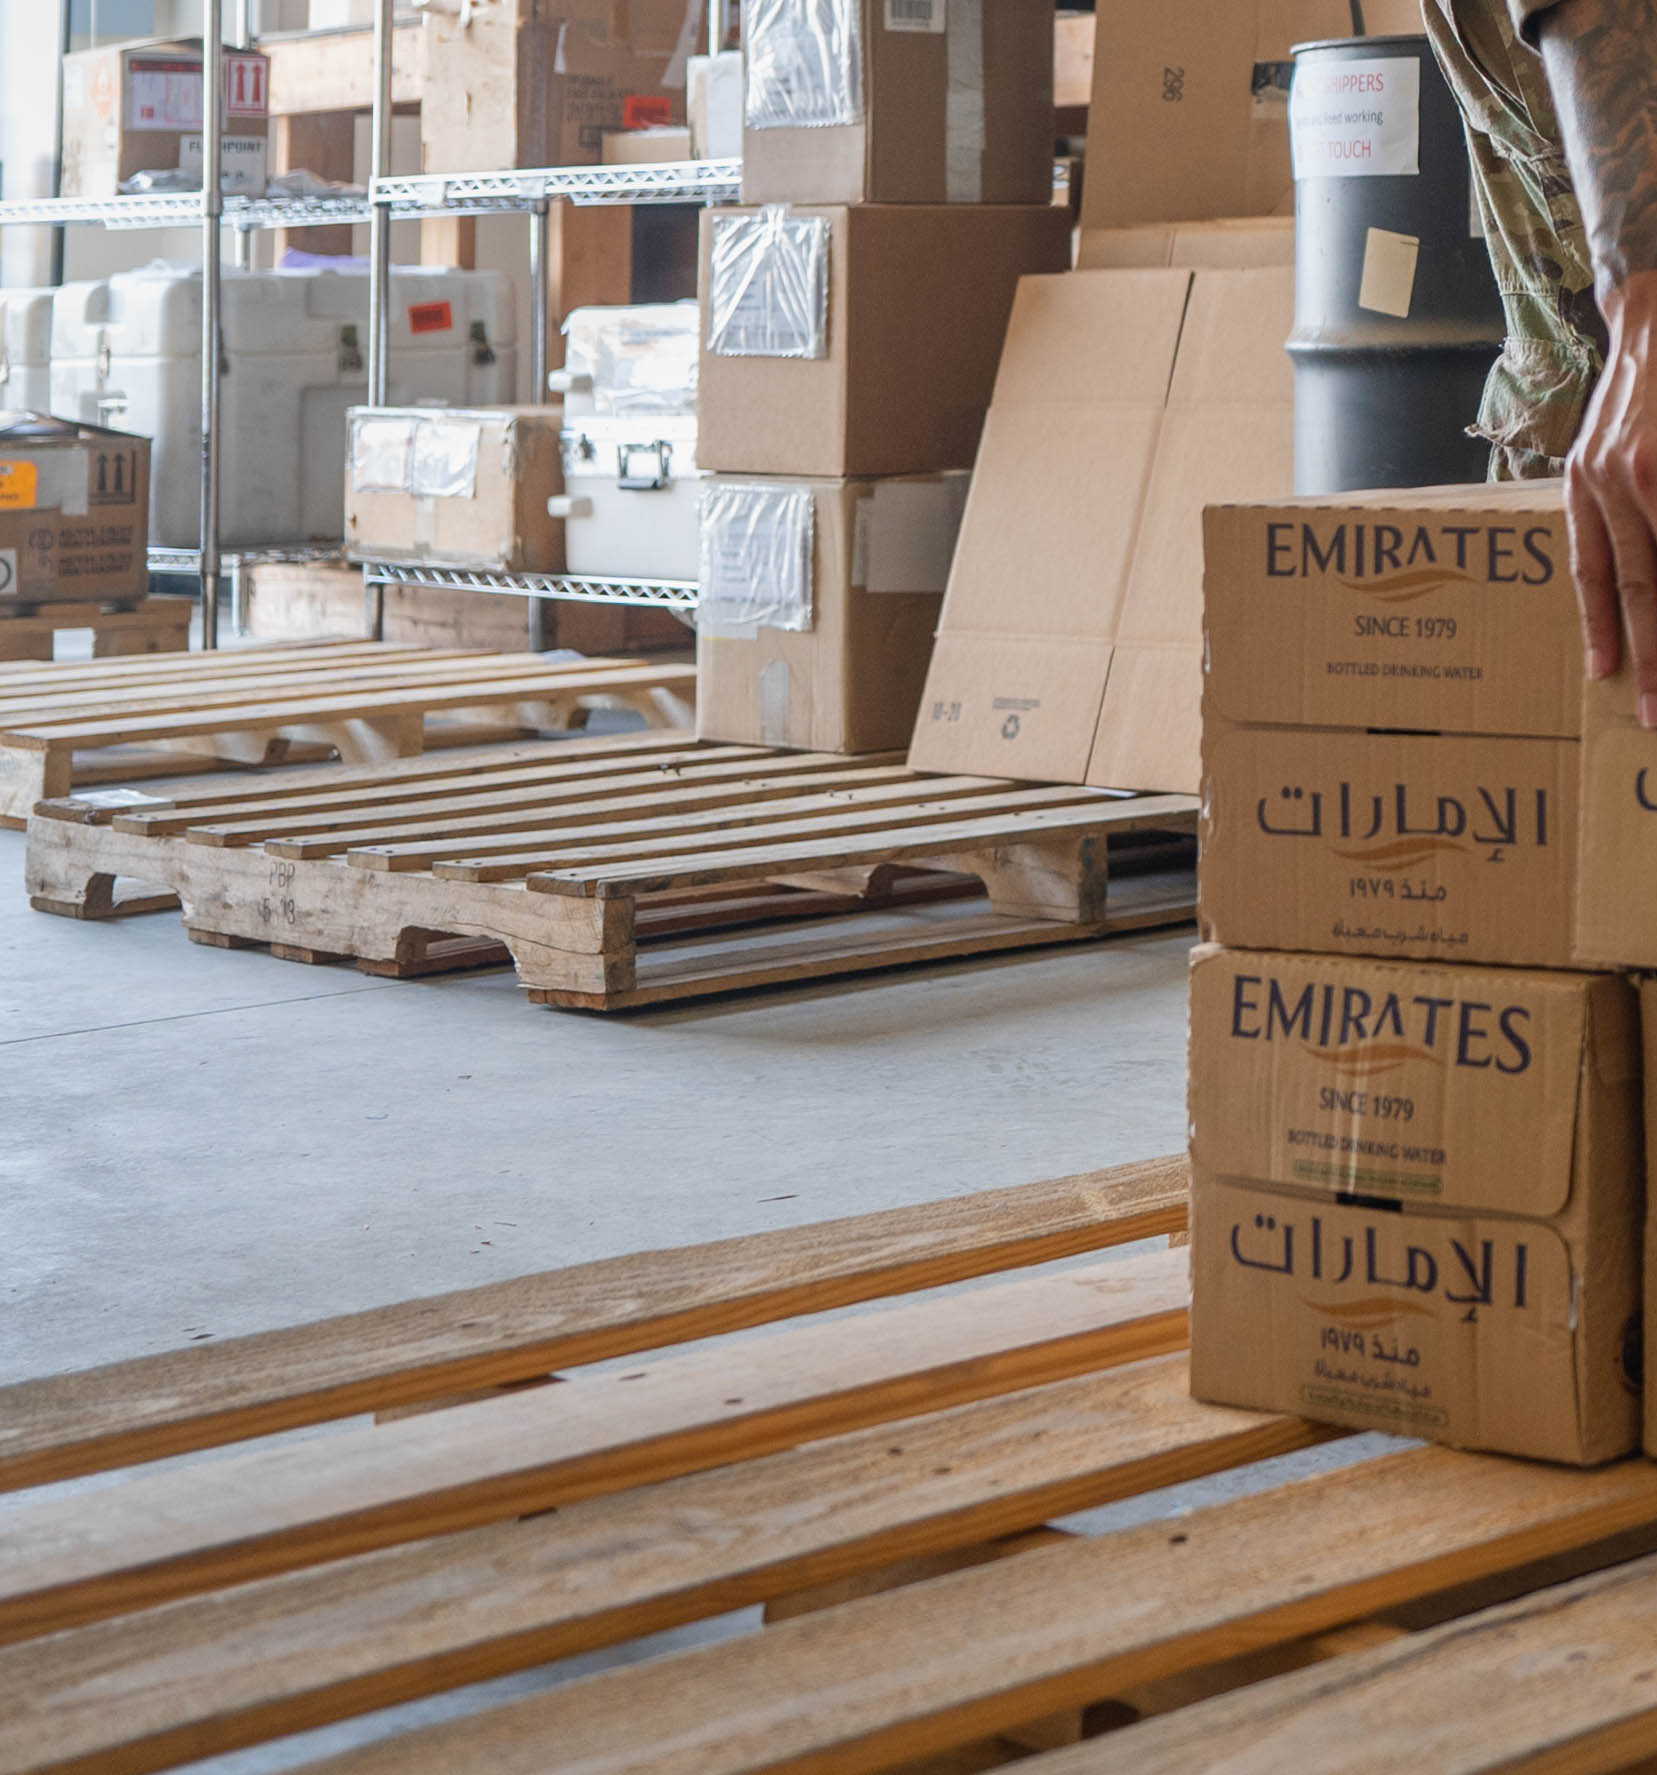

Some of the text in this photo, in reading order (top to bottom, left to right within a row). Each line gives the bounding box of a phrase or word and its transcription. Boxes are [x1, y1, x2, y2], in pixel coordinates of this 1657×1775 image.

[1344, 109, 1384, 126] working
[1266, 523, 1554, 585] EMIRATES
[1354, 614, 1457, 639] SINCE 1979
[1326, 661, 1484, 680] BOTTLED DRINKING WATER
[1257, 781, 1548, 863] الإمارات
[1349, 876, 1448, 902] منذ ١٩٧٩
[1230, 974, 1531, 1074] EMIRATES
[1320, 1087, 1414, 1121] SINCE 1979
[1287, 1129, 1446, 1165] BOTTLED DRINKING WATER
[1230, 1213, 1528, 1323] الإمارات
[1321, 1326, 1421, 1366] منذ ١٩٧٩
